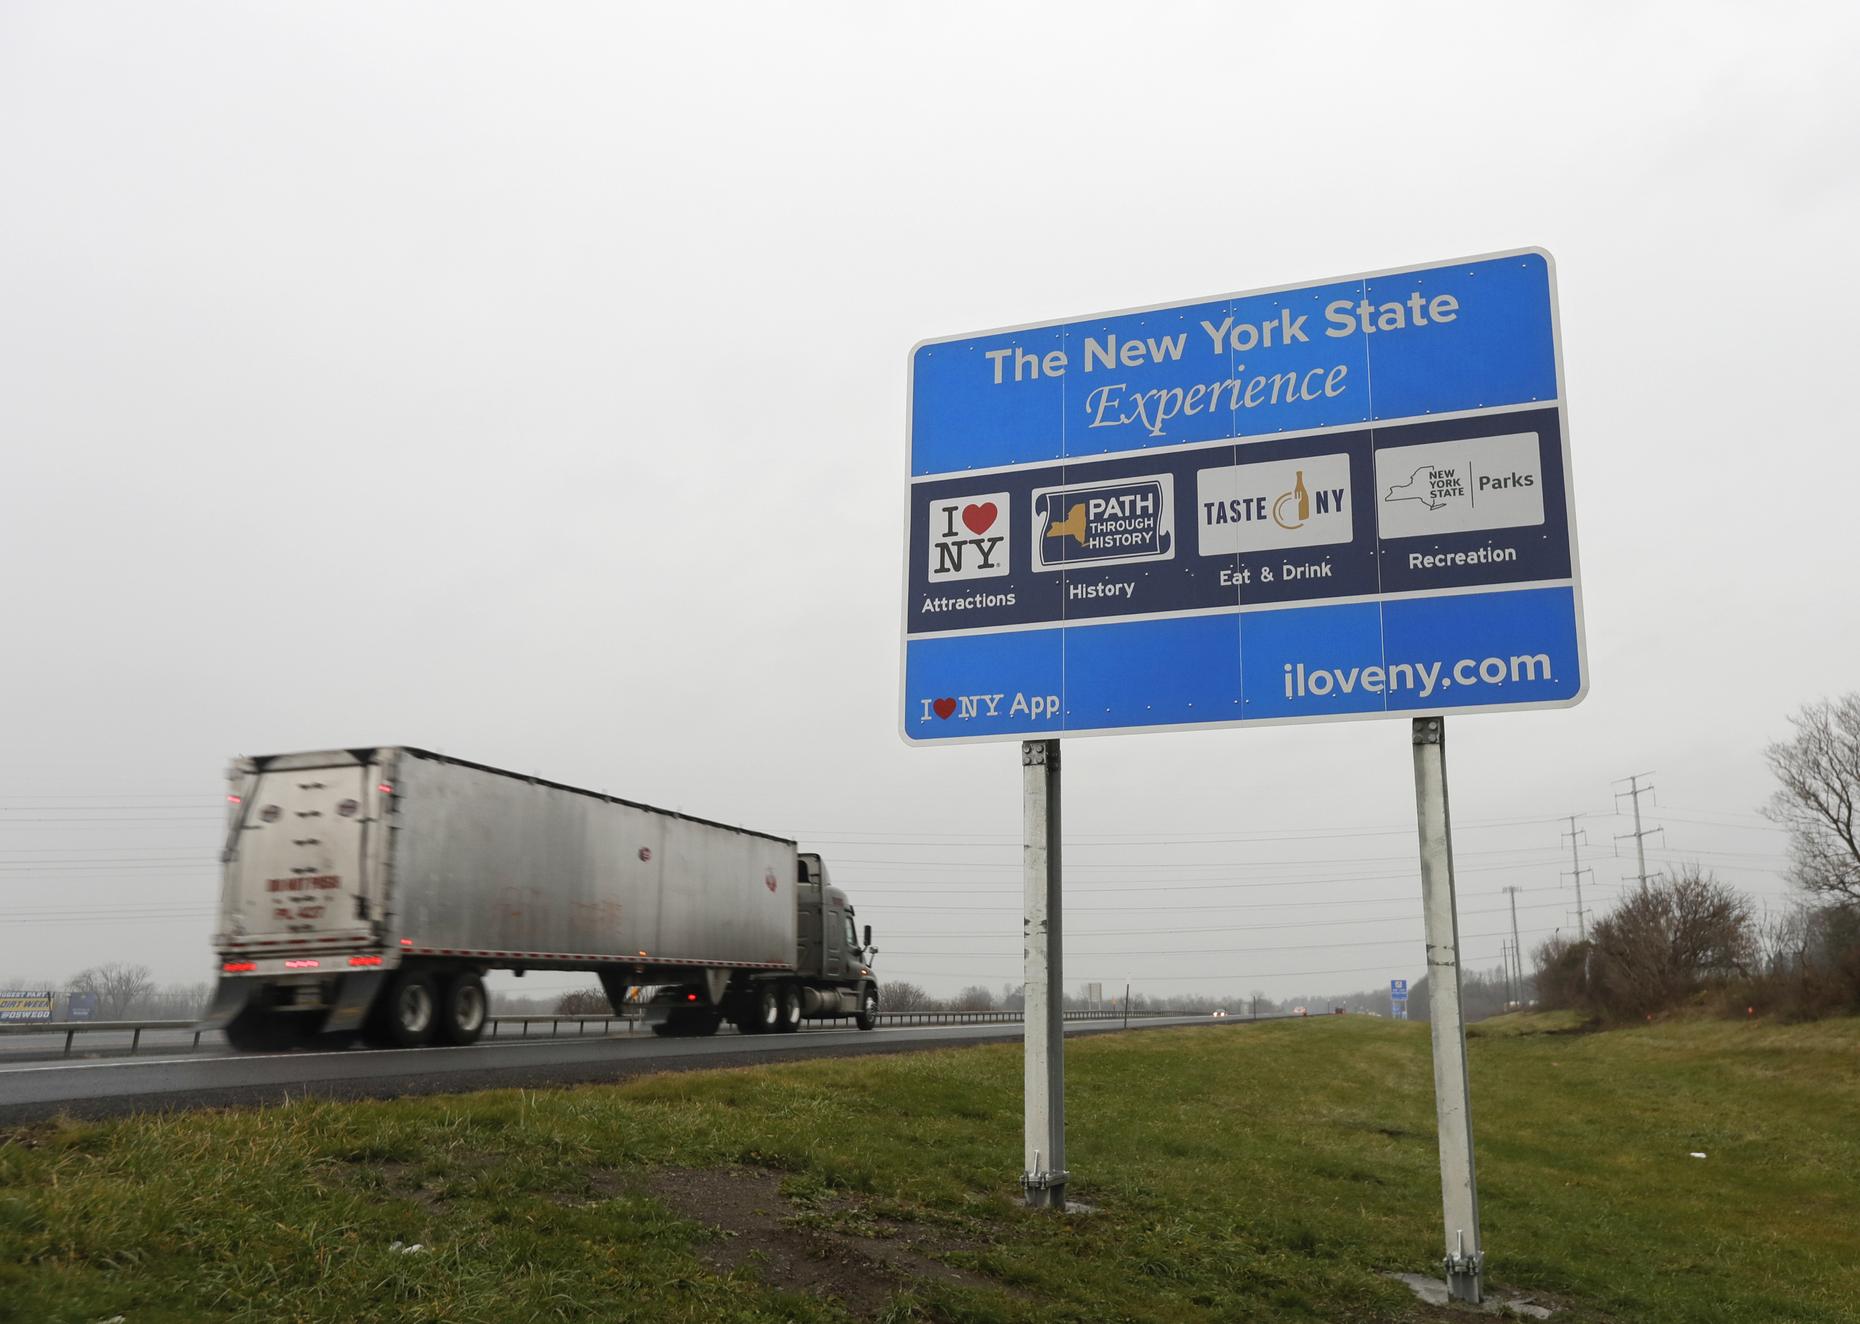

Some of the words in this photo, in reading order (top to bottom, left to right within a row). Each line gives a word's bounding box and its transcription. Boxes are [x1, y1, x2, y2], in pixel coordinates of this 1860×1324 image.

[986, 347, 1067, 384] The
[1083, 331, 1188, 373] New
[1199, 309, 1310, 356] York
[1324, 291, 1459, 338] State
[1085, 363, 1348, 437] Experience
[1429, 469, 1455, 480] NEW
[1429, 478, 1461, 489] YORK
[1479, 472, 1534, 491] Parks
[1430, 488, 1464, 499] STATE
[1089, 493, 1154, 520] PATH
[1204, 497, 1267, 525] TASTE
[1315, 489, 1344, 514] NY
[942, 506, 959, 537] I
[1089, 517, 1154, 534] THROUGH
[1089, 531, 1153, 549] HISTORY
[934, 536, 1004, 573] NY
[1409, 546, 1517, 569] Recreation
[1219, 568, 1251, 586] Eat
[1260, 566, 1274, 582] &
[1282, 562, 1332, 581] Drink
[921, 592, 1016, 613] Attractions
[1069, 582, 1135, 600] History
[1283, 653, 1552, 698] iloveny.com
[920, 698, 932, 721] I
[957, 693, 1005, 718] NY
[1010, 692, 1060, 720] App
